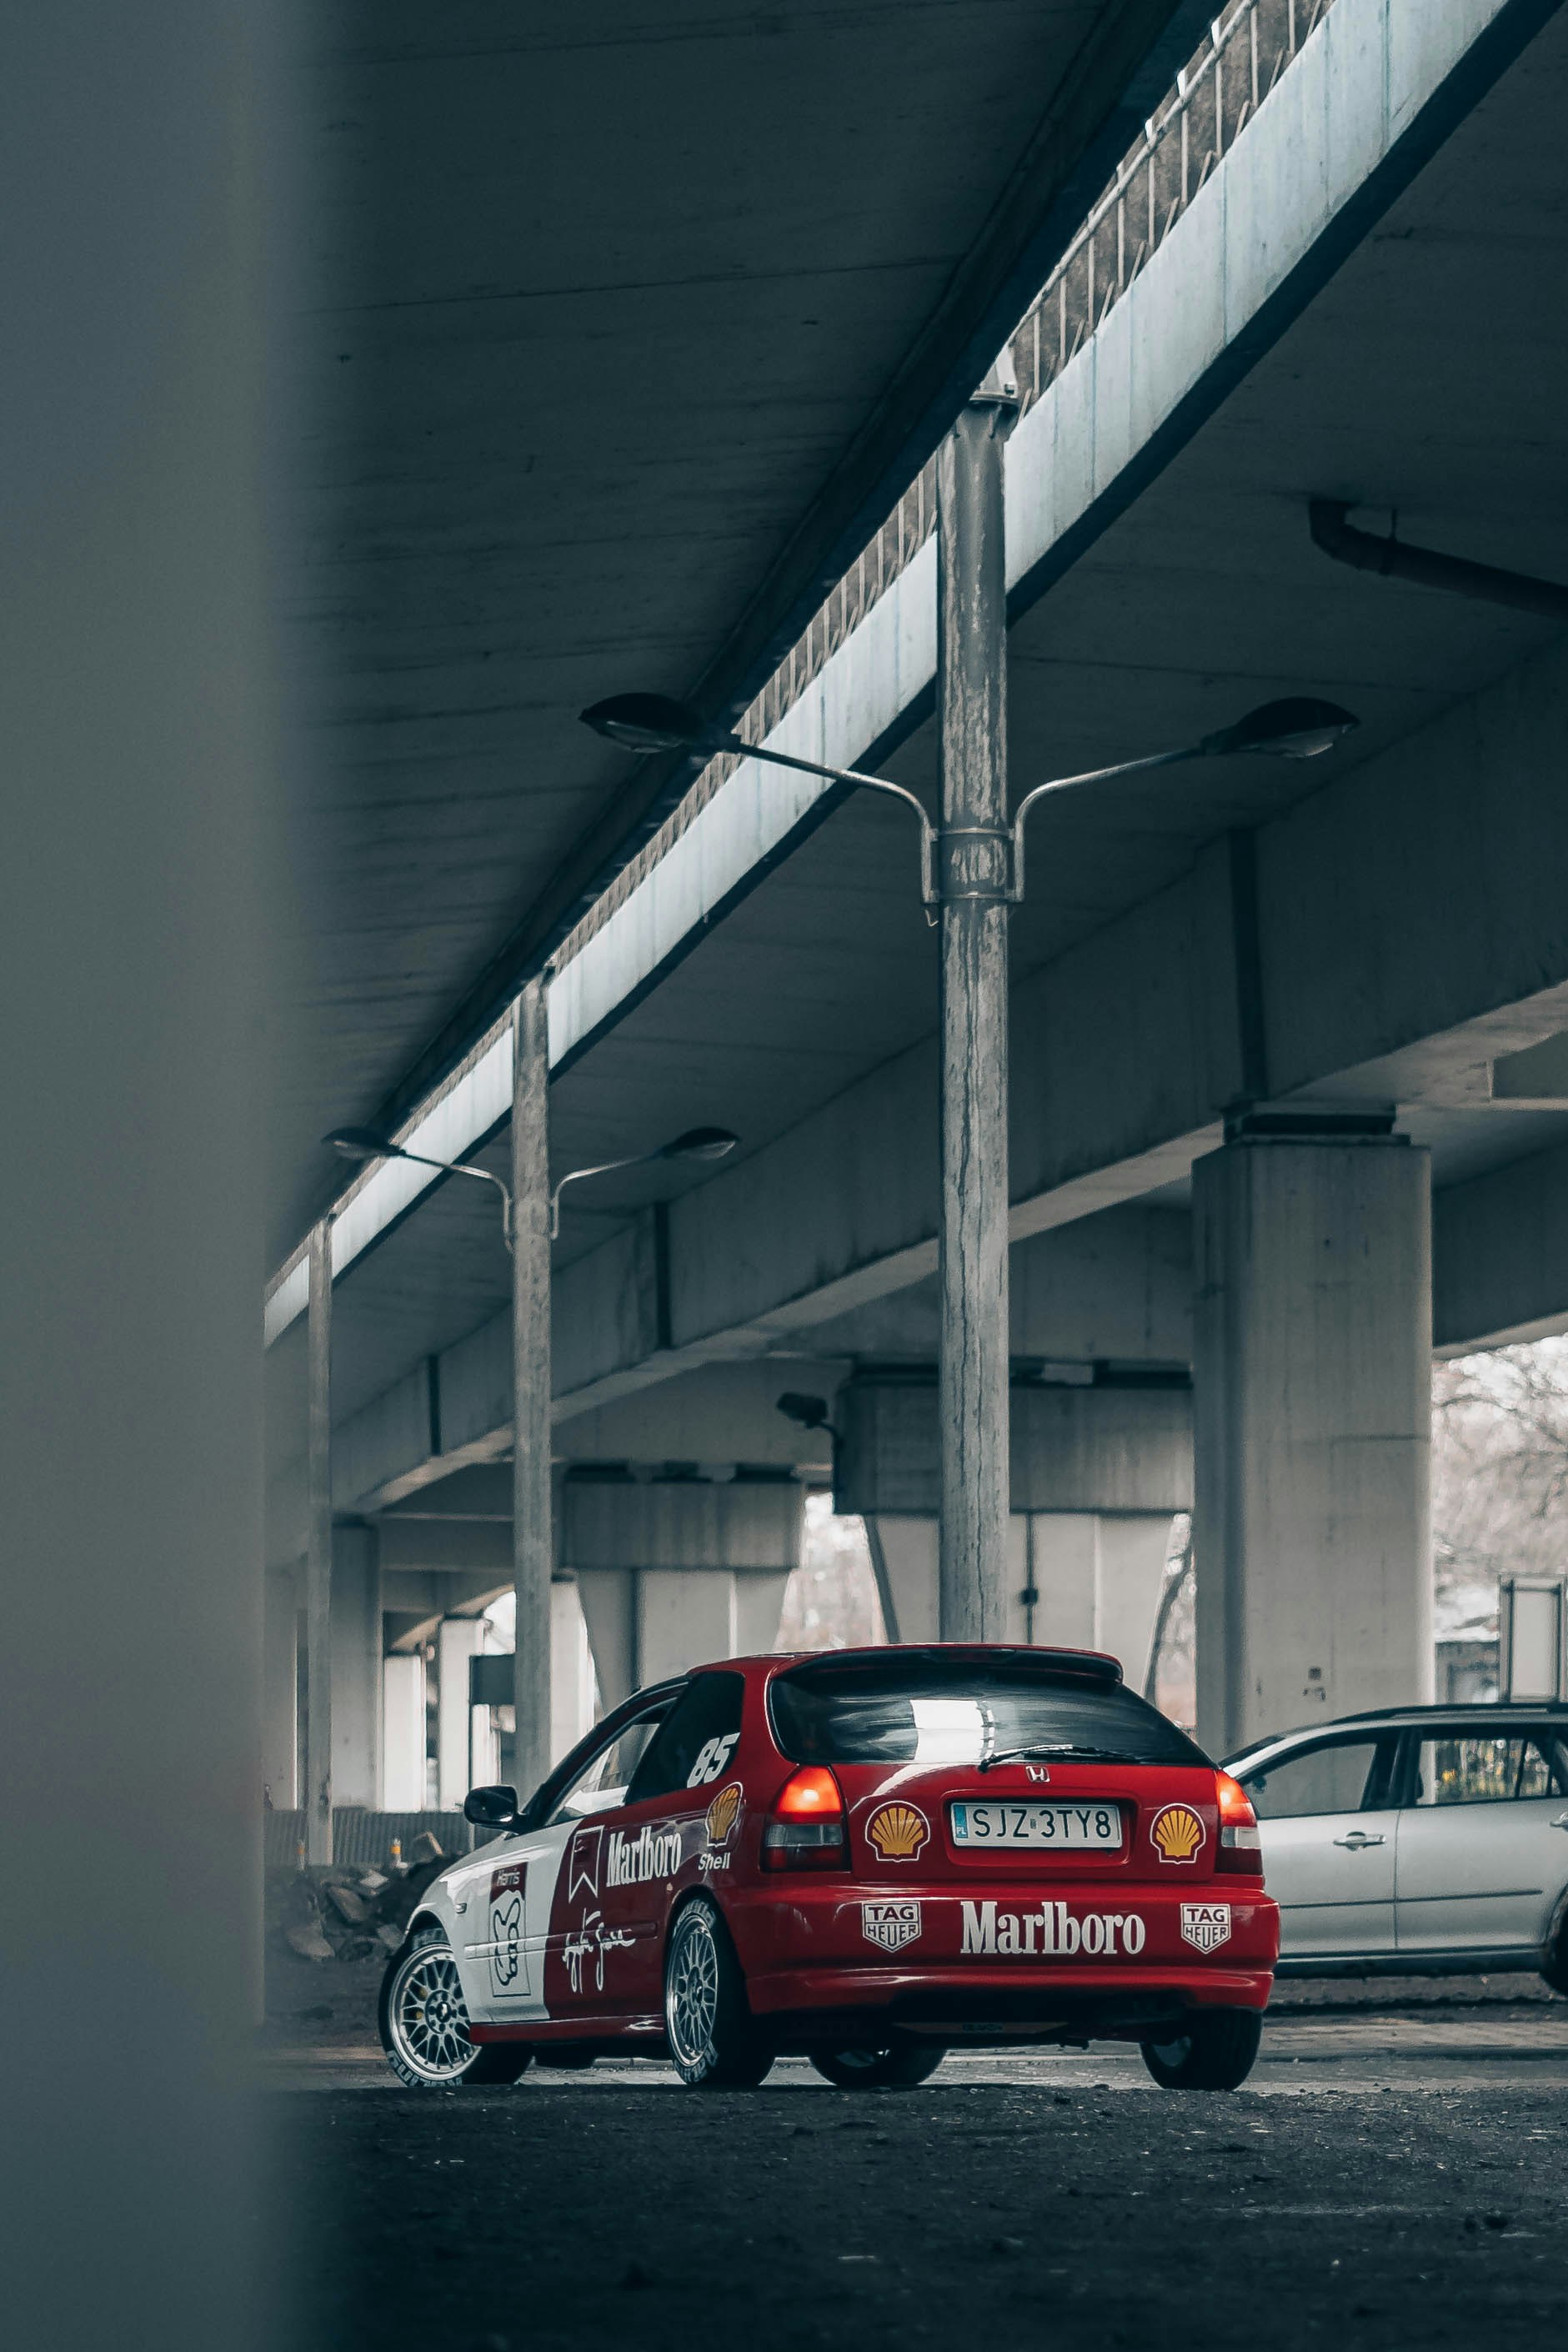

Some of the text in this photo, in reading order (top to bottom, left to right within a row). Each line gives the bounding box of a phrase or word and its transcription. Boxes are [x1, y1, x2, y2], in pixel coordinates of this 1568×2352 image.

[686, 1732, 741, 1789] 85
[972, 1808, 1111, 1838] SJZ 3TY8
[606, 1825, 682, 1888] Marlboro
[698, 1852, 731, 1871] Shell
[868, 1906, 914, 1921] TAG
[1186, 1908, 1225, 1923] TAG
[867, 1924, 916, 1947] HEUER
[959, 1900, 1146, 1955] Marlboro
[1185, 1927, 1228, 1948] HEUER
